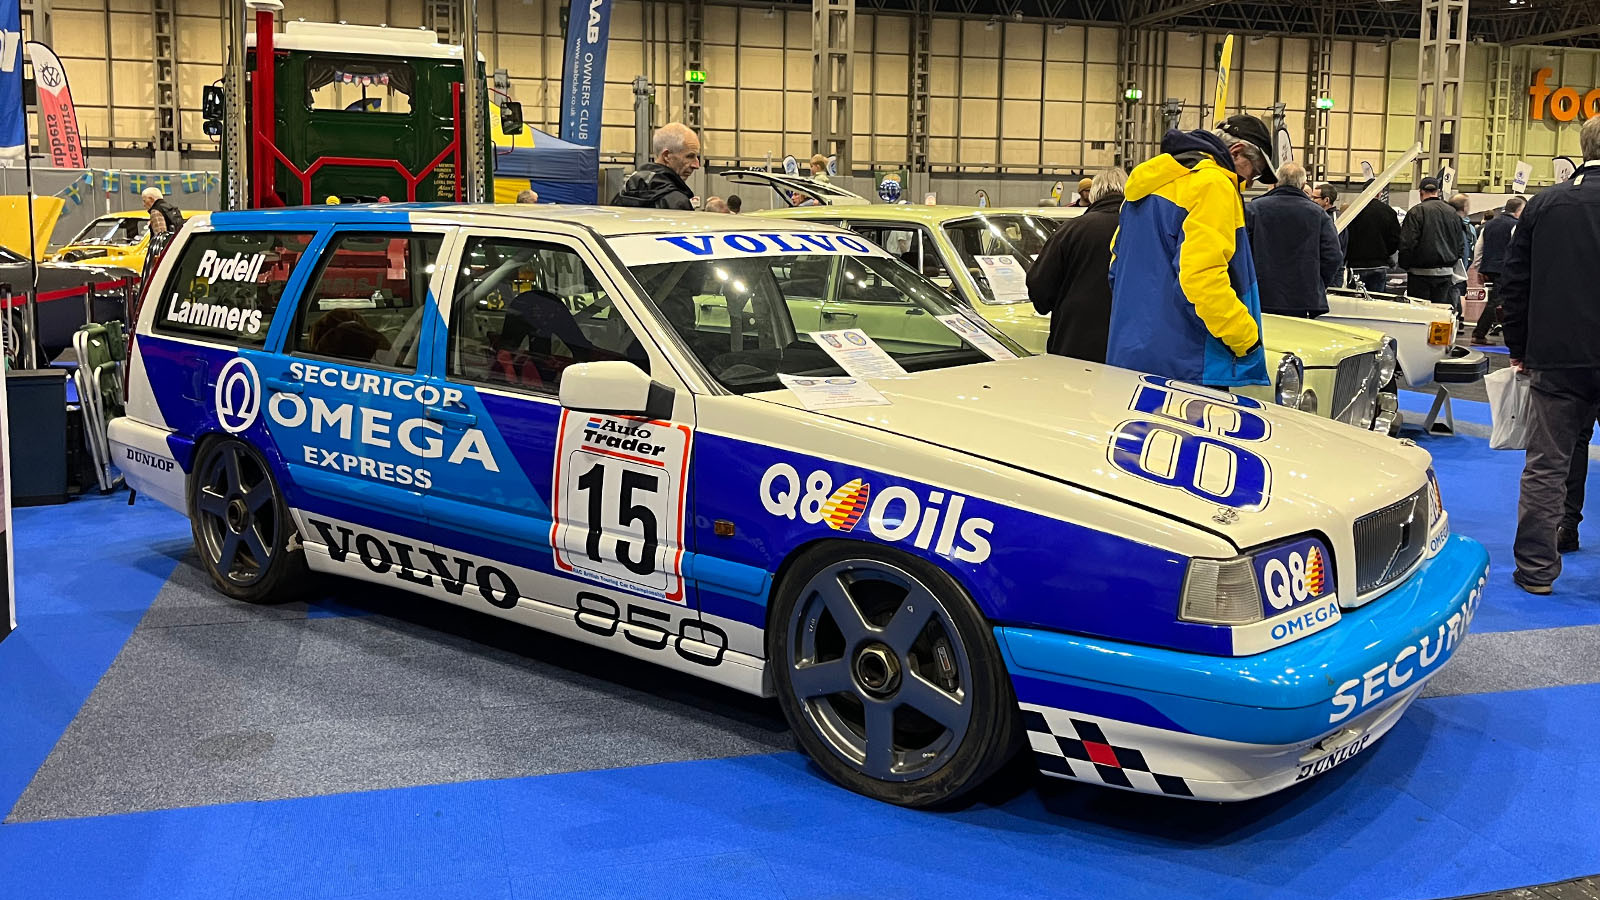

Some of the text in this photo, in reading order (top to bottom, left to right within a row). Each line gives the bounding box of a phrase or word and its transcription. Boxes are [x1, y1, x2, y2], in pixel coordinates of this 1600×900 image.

[570, 38, 581, 117] www.saabclub.co.uk
[581, 52, 593, 106] OWNERS
[578, 109, 589, 140] CLUB
[196, 249, 266, 285] Rydell
[655, 233, 870, 256] VOLVO
[166, 292, 263, 334] Lammers
[289, 362, 466, 409] SECURICOR
[268, 391, 500, 472] OMEGA
[583, 429, 666, 457] Trader
[599, 419, 652, 439] Auto
[1106, 373, 1273, 513] 850
[126, 448, 175, 472] DUNLOP
[303, 444, 433, 489] EXPRESS
[577, 463, 658, 576] 15
[759, 462, 995, 564] Q8 Oils
[1430, 523, 1449, 552] OMEG
[308, 518, 521, 610] VOLVO
[1263, 551, 1309, 610] Q8
[574, 591, 729, 667] 850
[1271, 602, 1339, 640] OMEGA
[1295, 733, 1370, 781] DUNLOP
